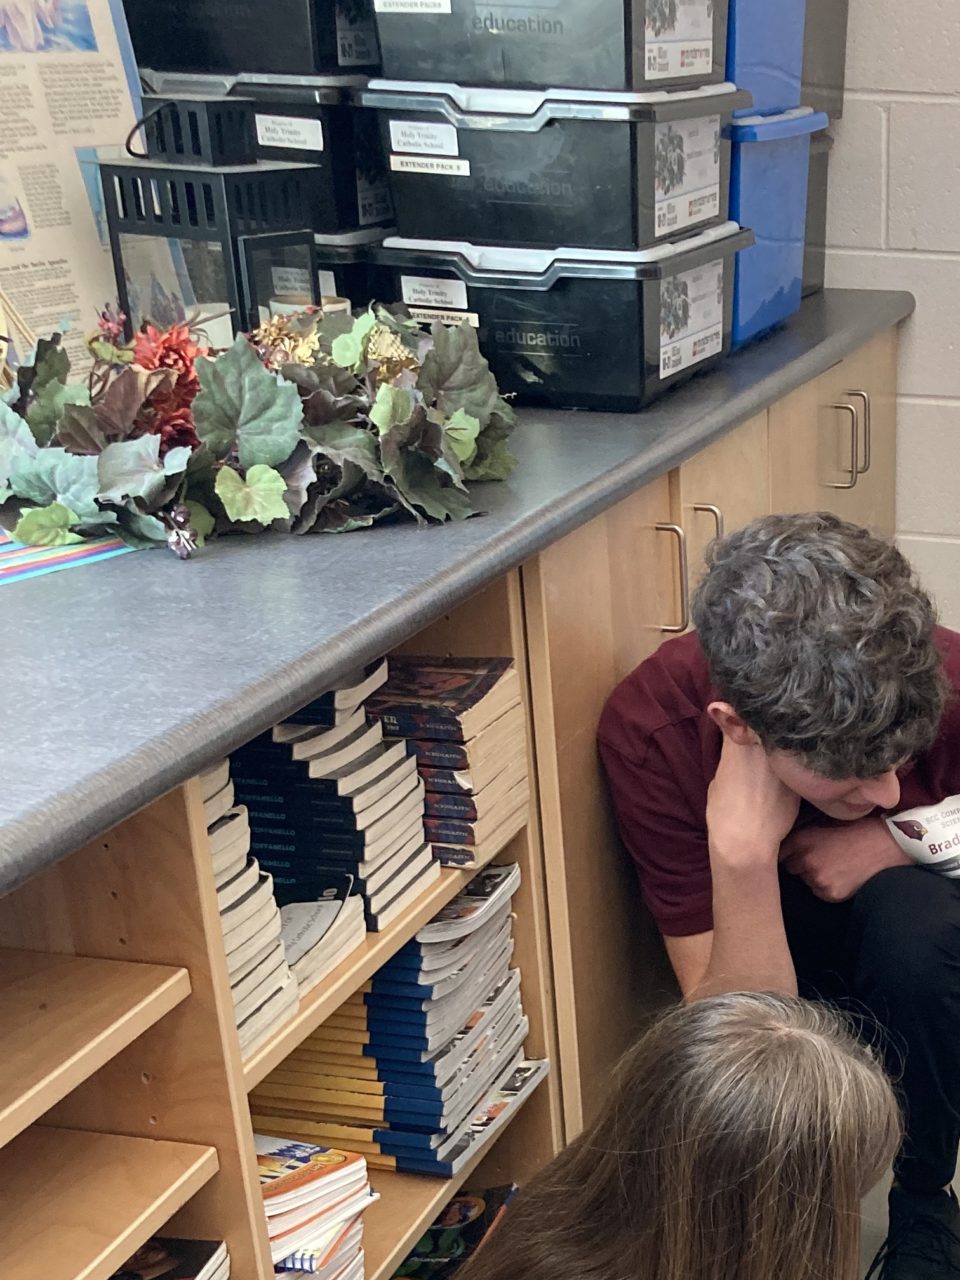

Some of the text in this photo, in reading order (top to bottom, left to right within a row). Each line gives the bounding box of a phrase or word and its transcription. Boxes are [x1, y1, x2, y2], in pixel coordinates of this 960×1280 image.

[472, 12, 564, 35] education
[400, 160, 435, 171] EXTENDER
[495, 327, 581, 348] education
